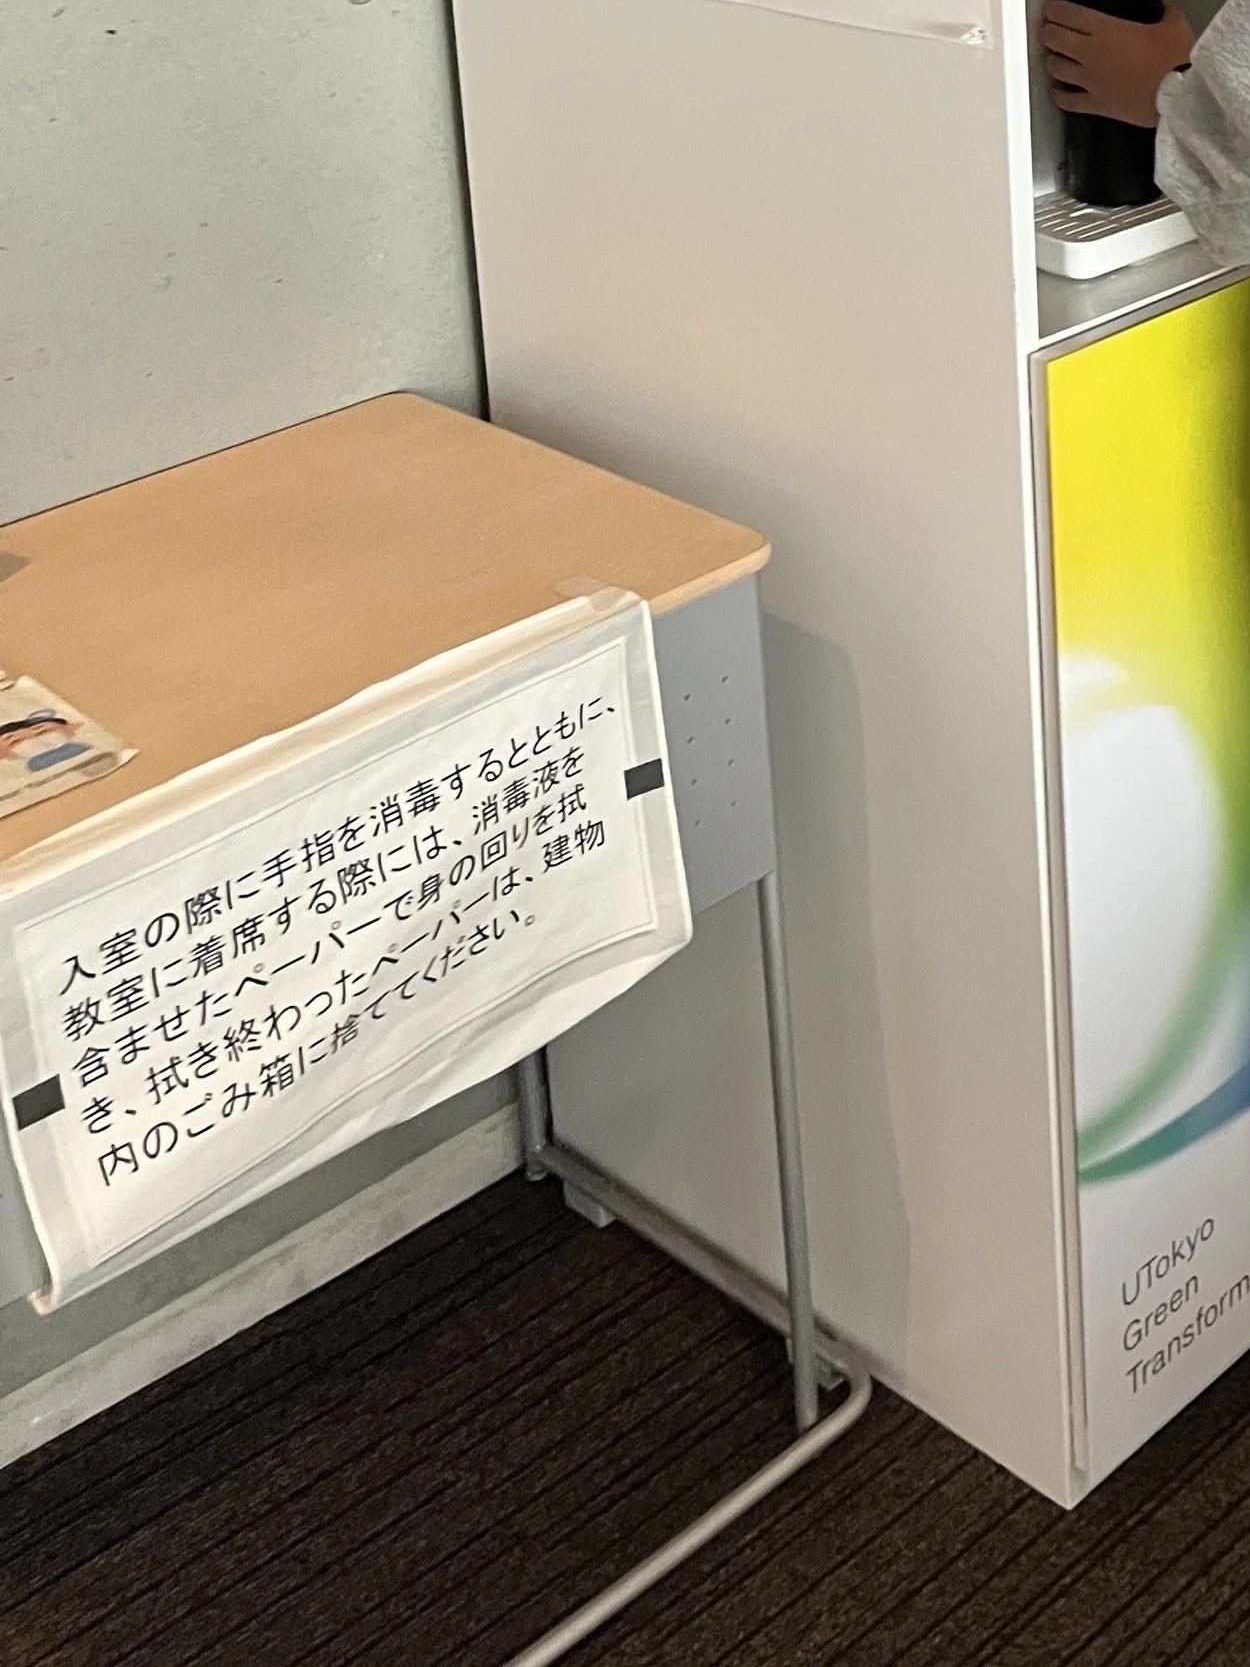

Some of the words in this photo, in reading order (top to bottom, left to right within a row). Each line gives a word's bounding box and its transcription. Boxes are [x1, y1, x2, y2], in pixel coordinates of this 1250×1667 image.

[59, 695, 617, 995] 入室の際に手指を消毒するとともに、
[63, 745, 586, 1041] 教室に着席する際には、消毒液を
[71, 786, 588, 1088] 含ませたペーパーで身の回りを拭
[80, 818, 607, 1135] き、拭き終わったペーパーは、建物
[98, 911, 537, 1186] 内のごみ箱に捨ててください。
[1121, 1218, 1214, 1306] UTokyo
[1123, 1275, 1198, 1351] Green
